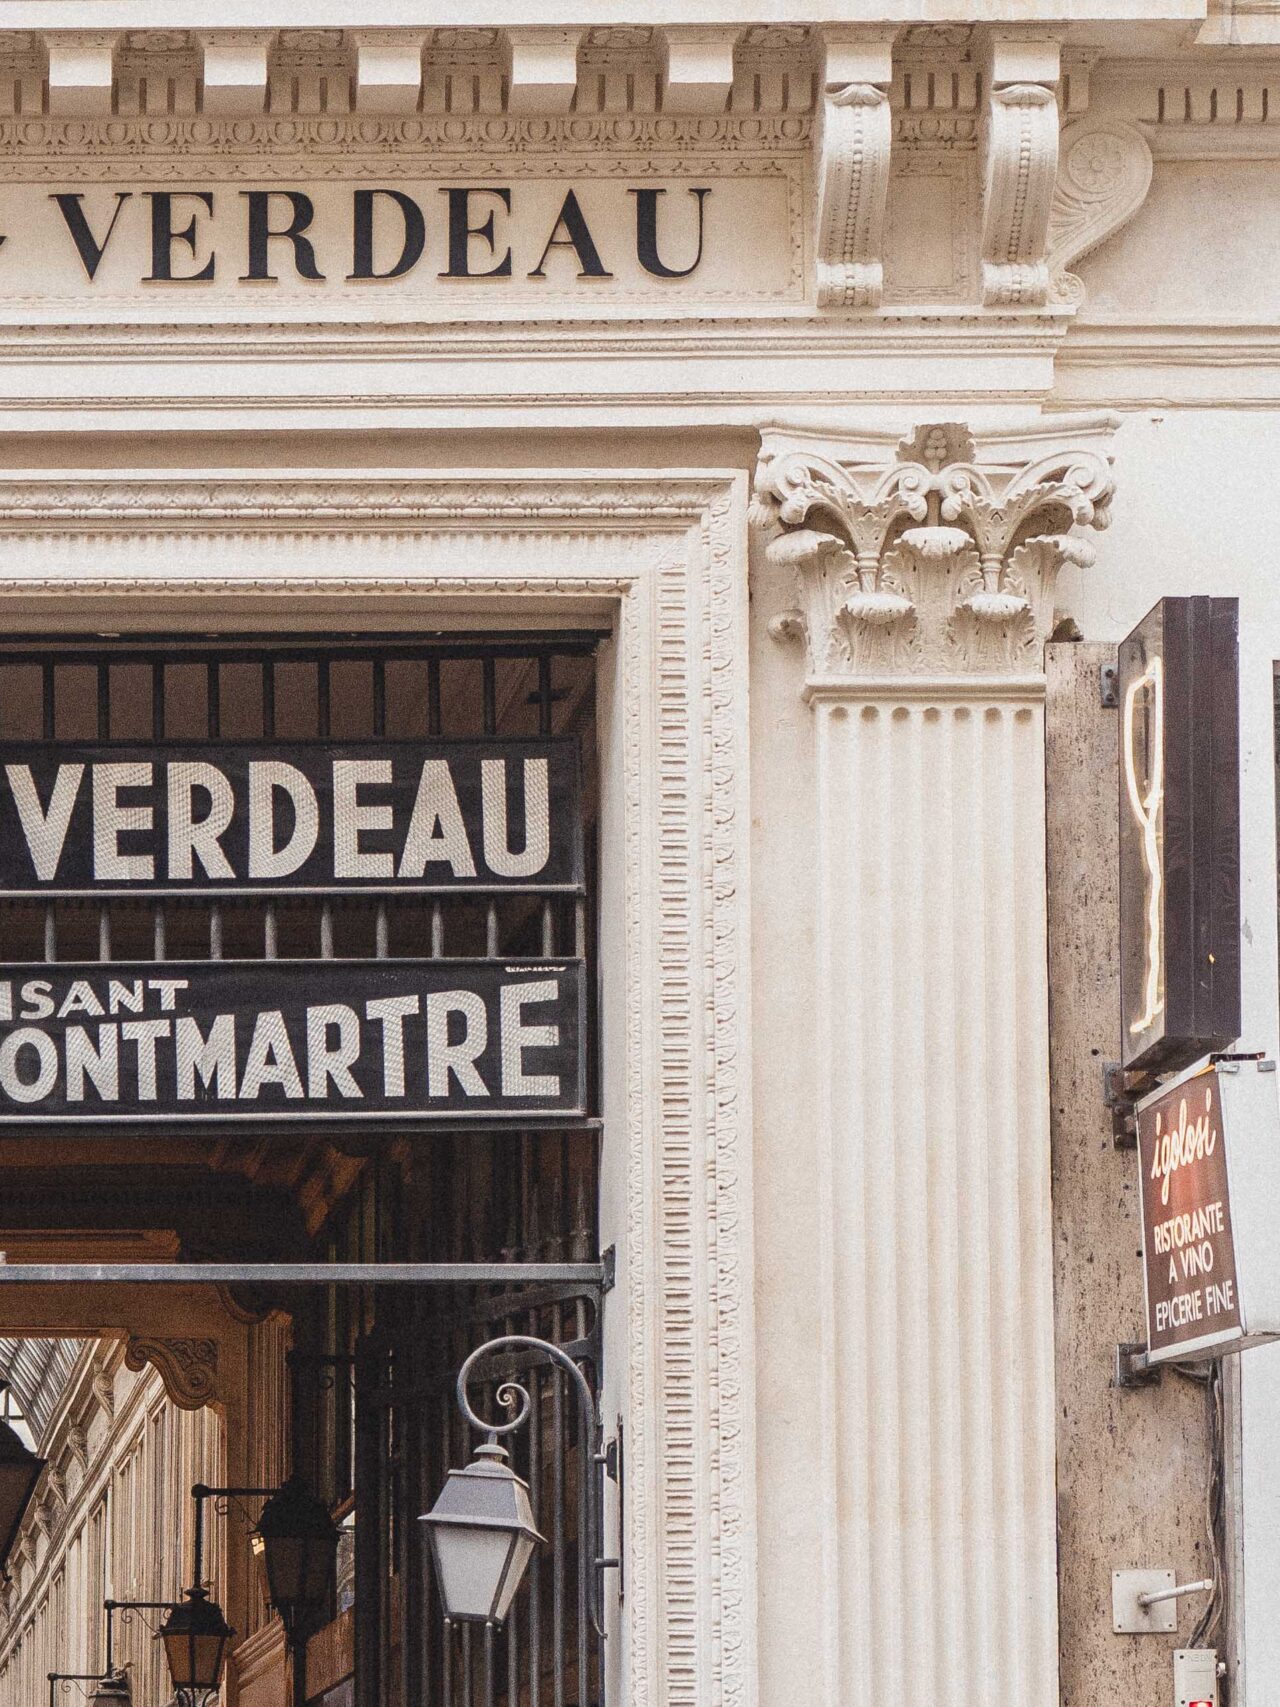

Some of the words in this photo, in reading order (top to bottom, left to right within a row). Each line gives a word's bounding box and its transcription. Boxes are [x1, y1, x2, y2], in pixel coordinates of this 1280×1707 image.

[48, 187, 712, 282] VERDEAU
[4, 758, 551, 882] VERDEAU
[1154, 1202, 1224, 1255] RISTORANTE
[1168, 1255, 1178, 1284] A
[1180, 1241, 1213, 1278] VINO
[1155, 1289, 1202, 1332] EPICERIE
[1205, 1279, 1234, 1316] FINE
